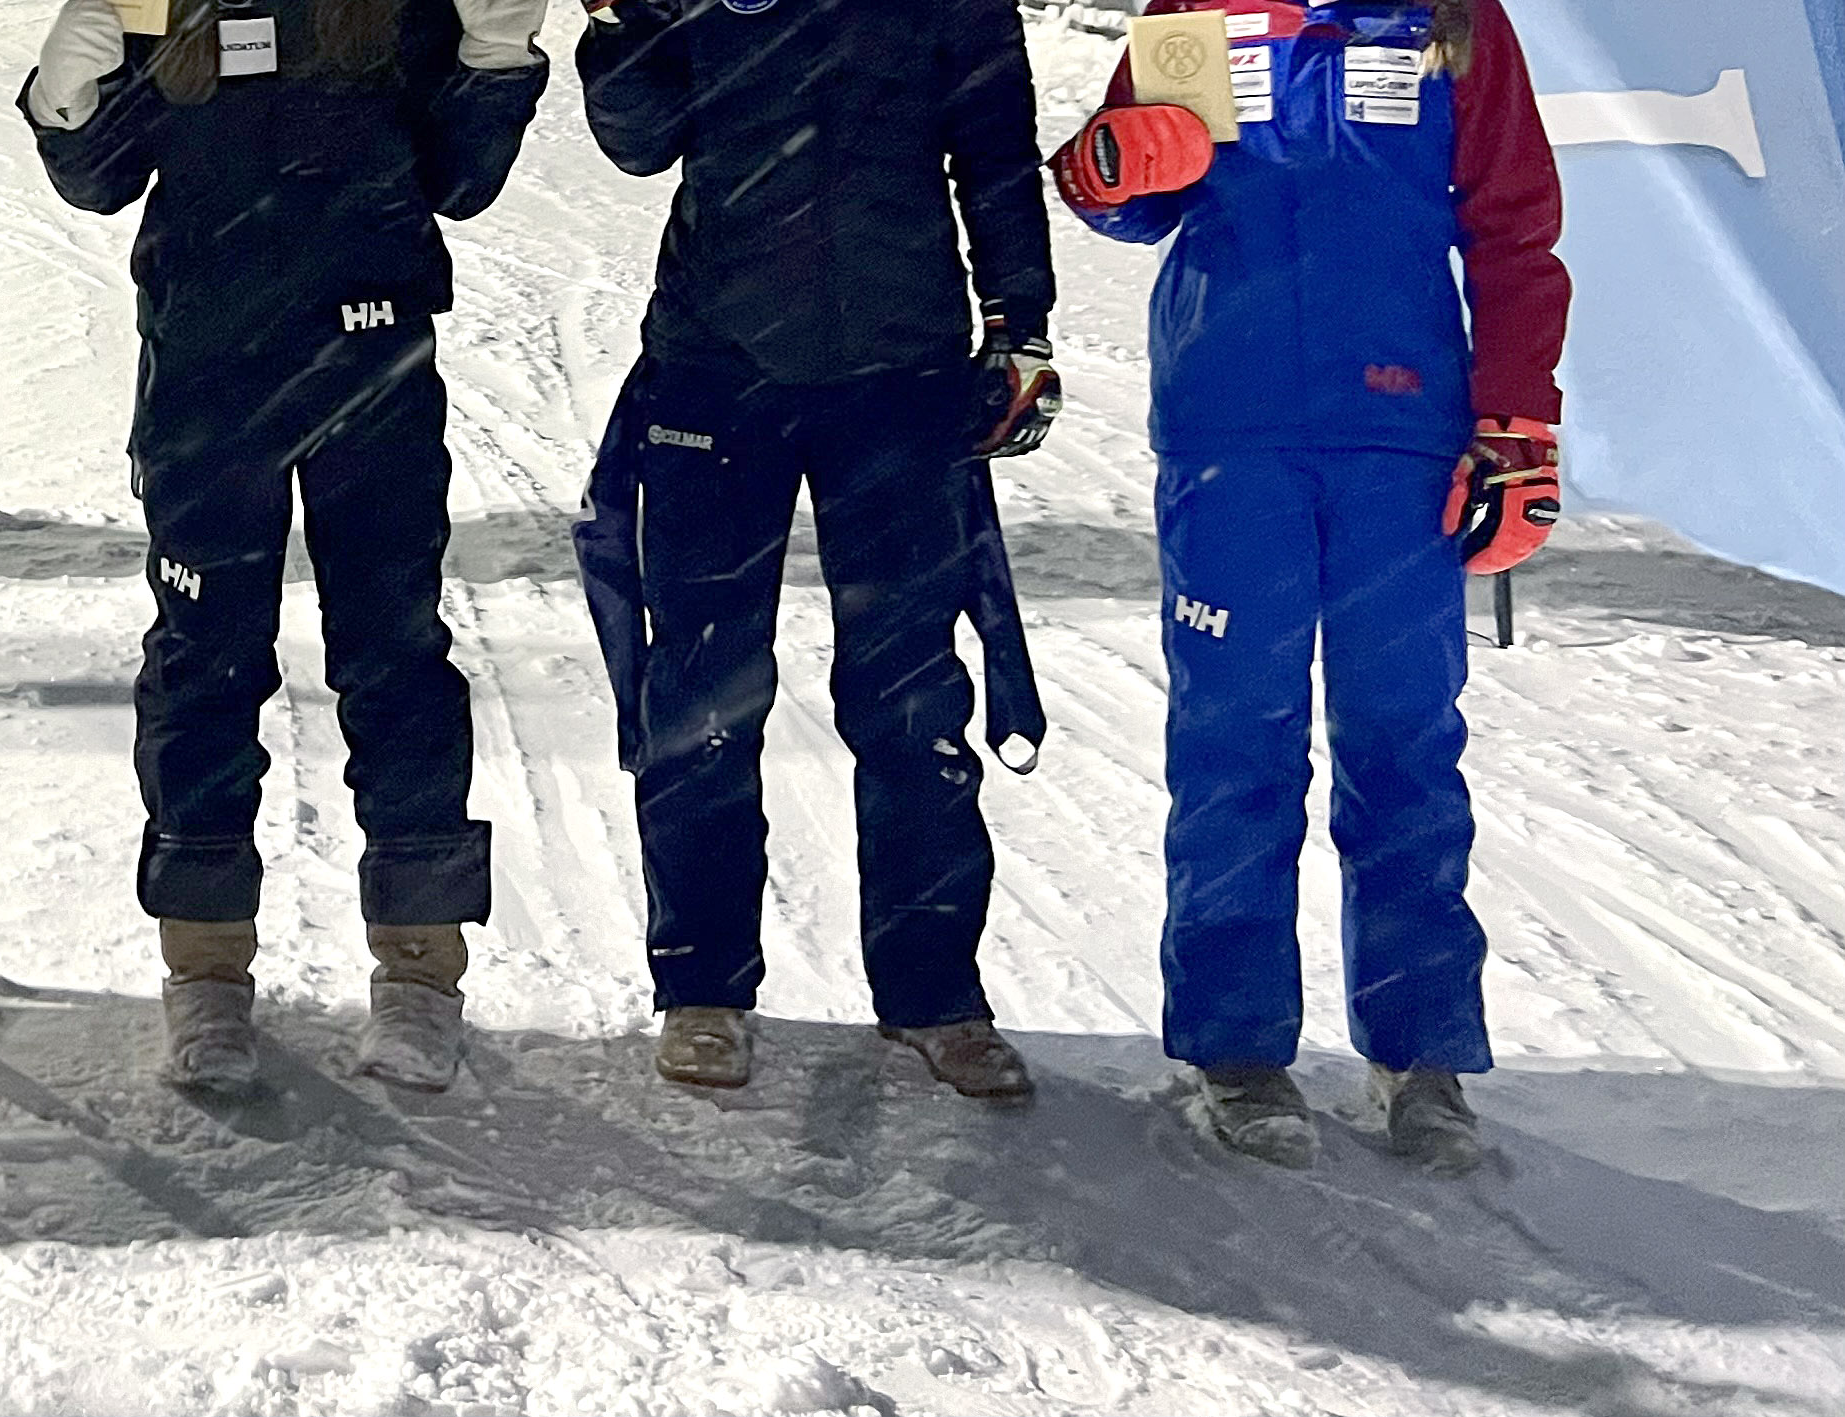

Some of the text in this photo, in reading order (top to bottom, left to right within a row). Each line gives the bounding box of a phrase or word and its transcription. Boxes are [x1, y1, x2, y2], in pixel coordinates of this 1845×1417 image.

[342, 301, 394, 331] HH
[160, 557, 202, 601] HH
[1175, 594, 1229, 638] HH
